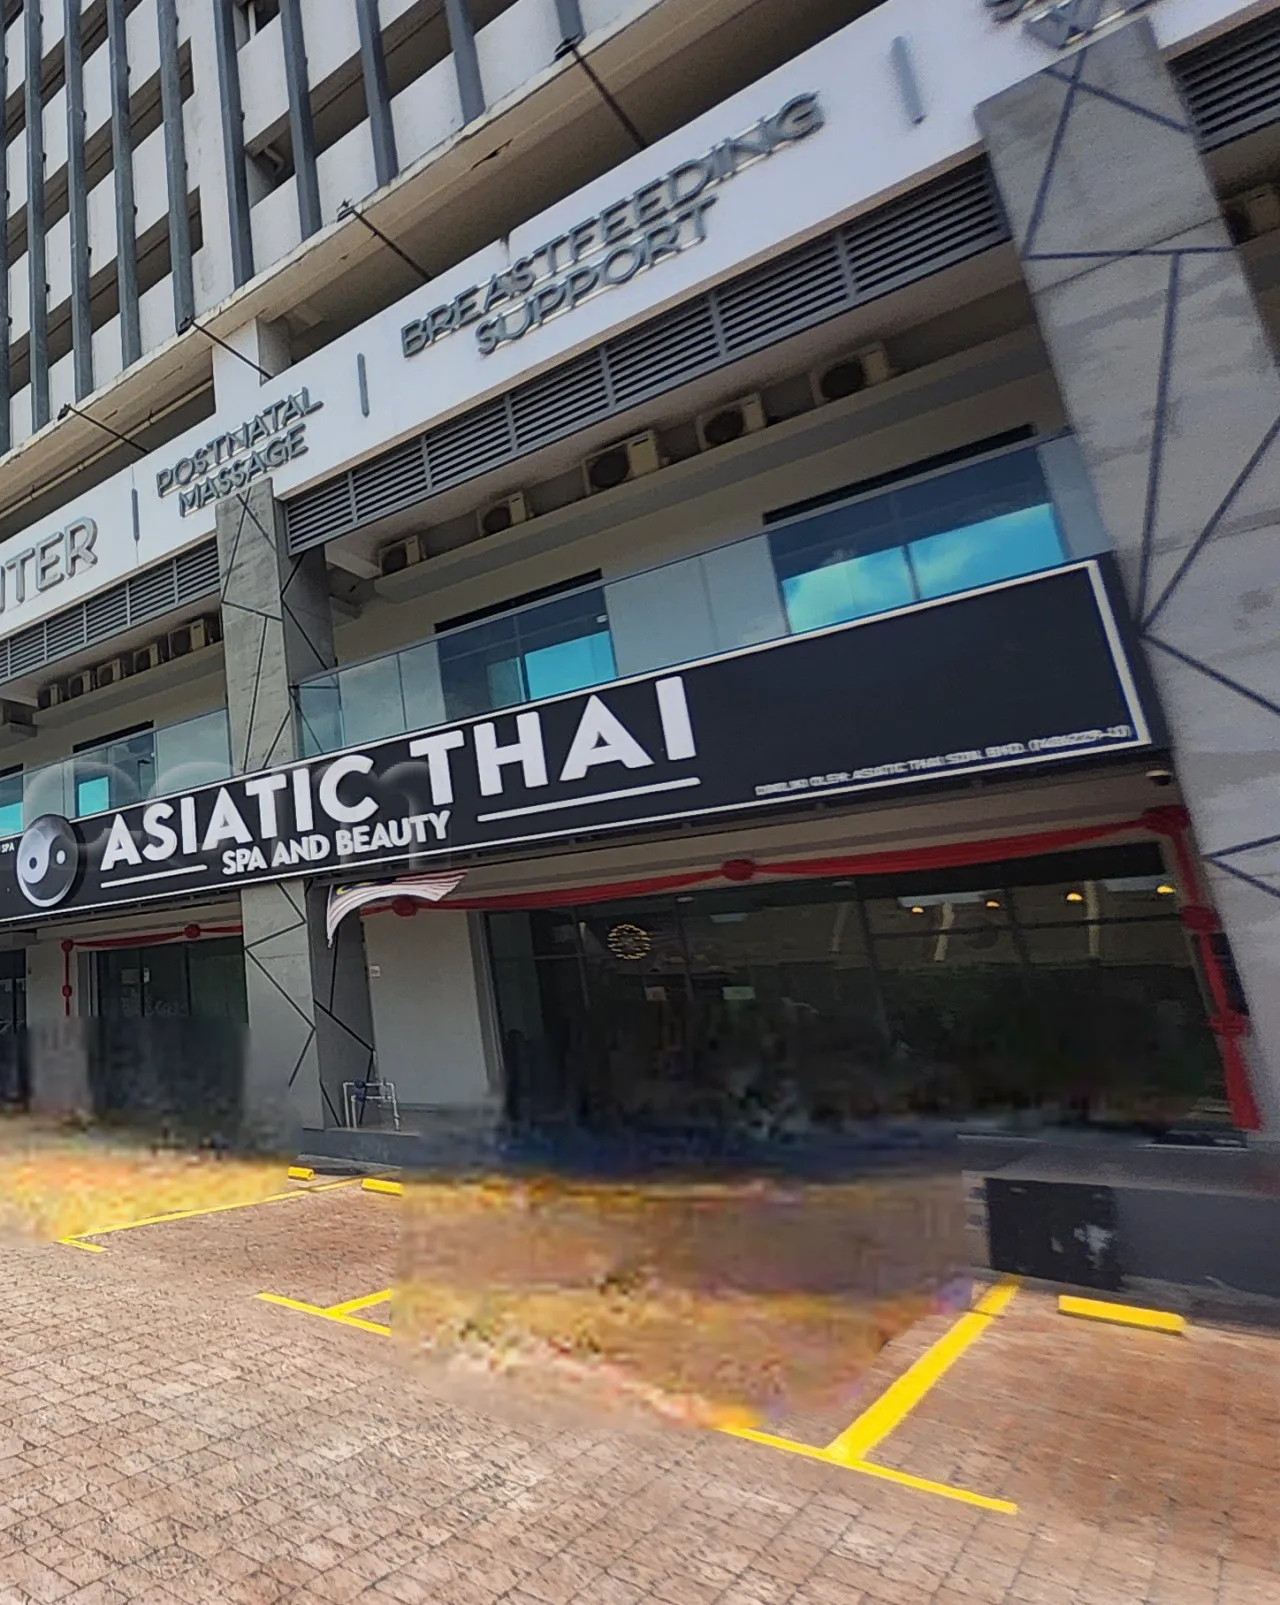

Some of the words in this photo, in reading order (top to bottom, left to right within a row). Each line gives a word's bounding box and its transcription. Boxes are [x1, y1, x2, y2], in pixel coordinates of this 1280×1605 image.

[401, 90, 824, 358] BREASTFEEDING
[476, 195, 718, 356] SUPPORT
[155, 385, 323, 497] POSTNATAL
[178, 421, 309, 517] MASSAGE
[100, 753, 380, 872] ASIATIC
[409, 675, 697, 807] THAI
[1, 842, 15, 853] SPA
[222, 841, 267, 875] SPA
[265, 830, 332, 868] AND
[336, 809, 452, 856] BEAUTY
